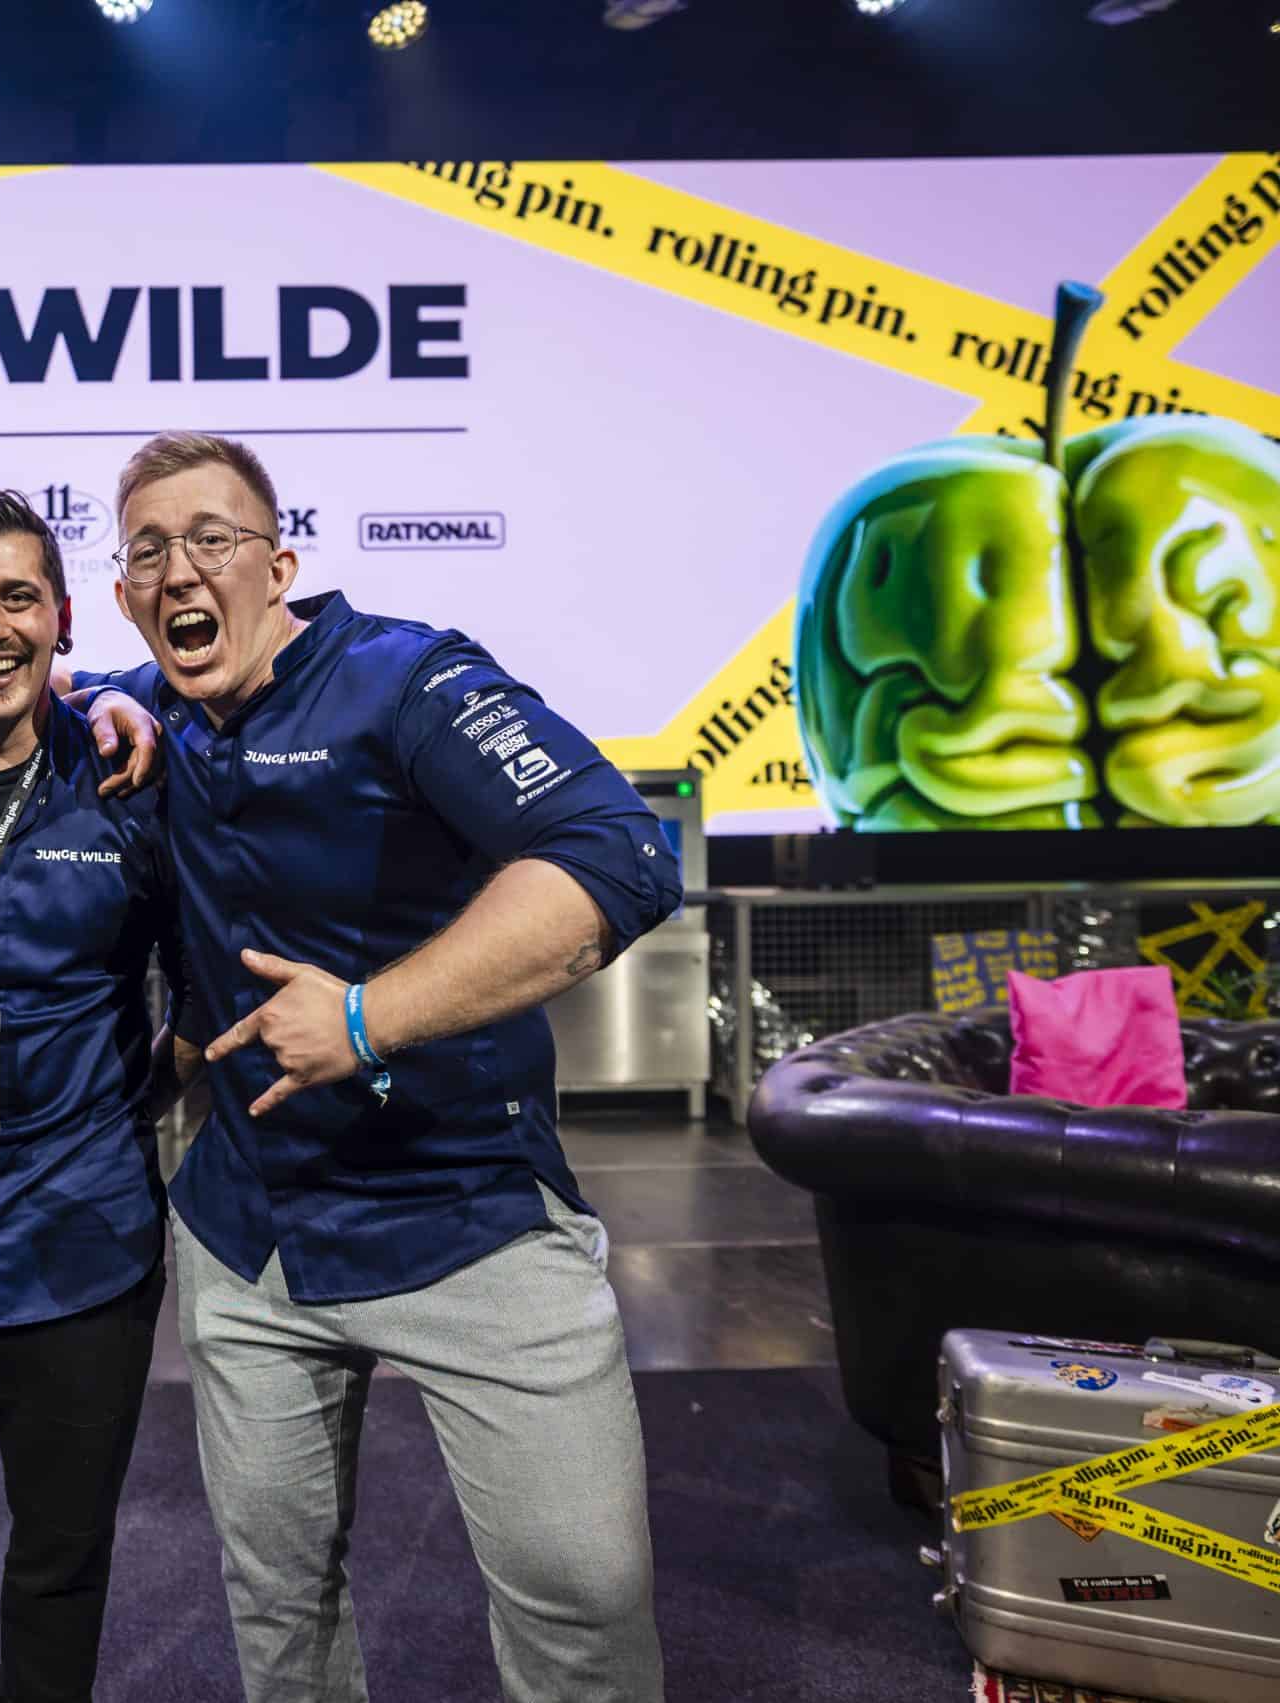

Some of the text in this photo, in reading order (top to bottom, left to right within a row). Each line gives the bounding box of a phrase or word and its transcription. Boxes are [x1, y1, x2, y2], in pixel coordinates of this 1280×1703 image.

[515, 179, 614, 238] pin.
[1116, 193, 1265, 341] rolling
[645, 225, 917, 342] rolling pin.
[949, 331, 1122, 419] rollng
[367, 521, 497, 542] RATIONAL
[244, 749, 329, 765] JUNGE WILDE
[35, 849, 121, 863] JUNGE WILDE
[1219, 1428, 1259, 1453] pin.
[1196, 1542, 1238, 1564] pin.
